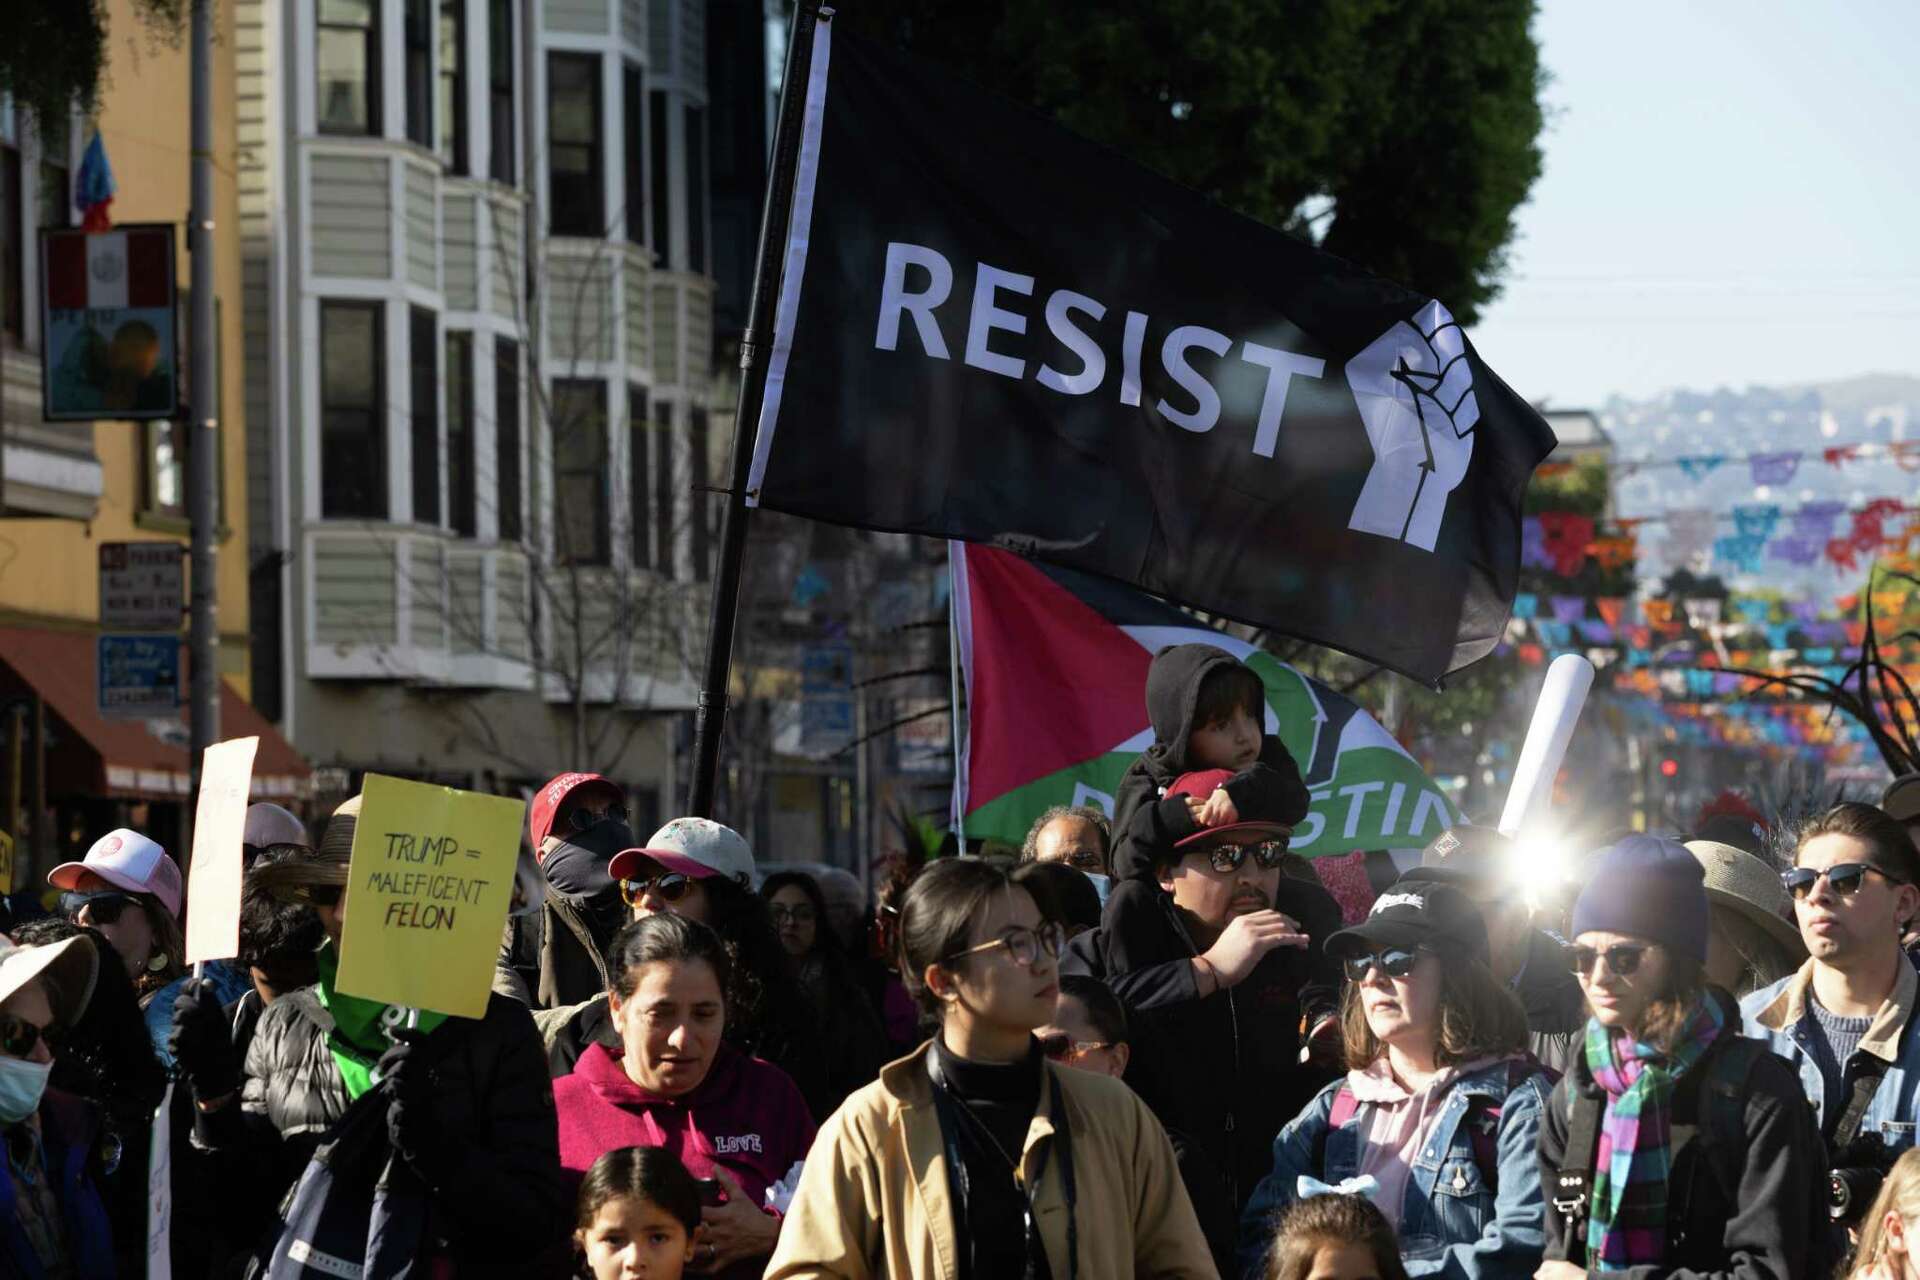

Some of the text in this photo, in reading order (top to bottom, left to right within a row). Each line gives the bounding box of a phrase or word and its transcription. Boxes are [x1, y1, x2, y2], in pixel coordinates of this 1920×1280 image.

[875, 242, 1326, 458] RESIST
[384, 833, 482, 867] TRUMP =
[366, 872, 490, 905] MALEFICENT
[384, 901, 456, 931] FELON
[715, 1133, 763, 1153] LOVE
